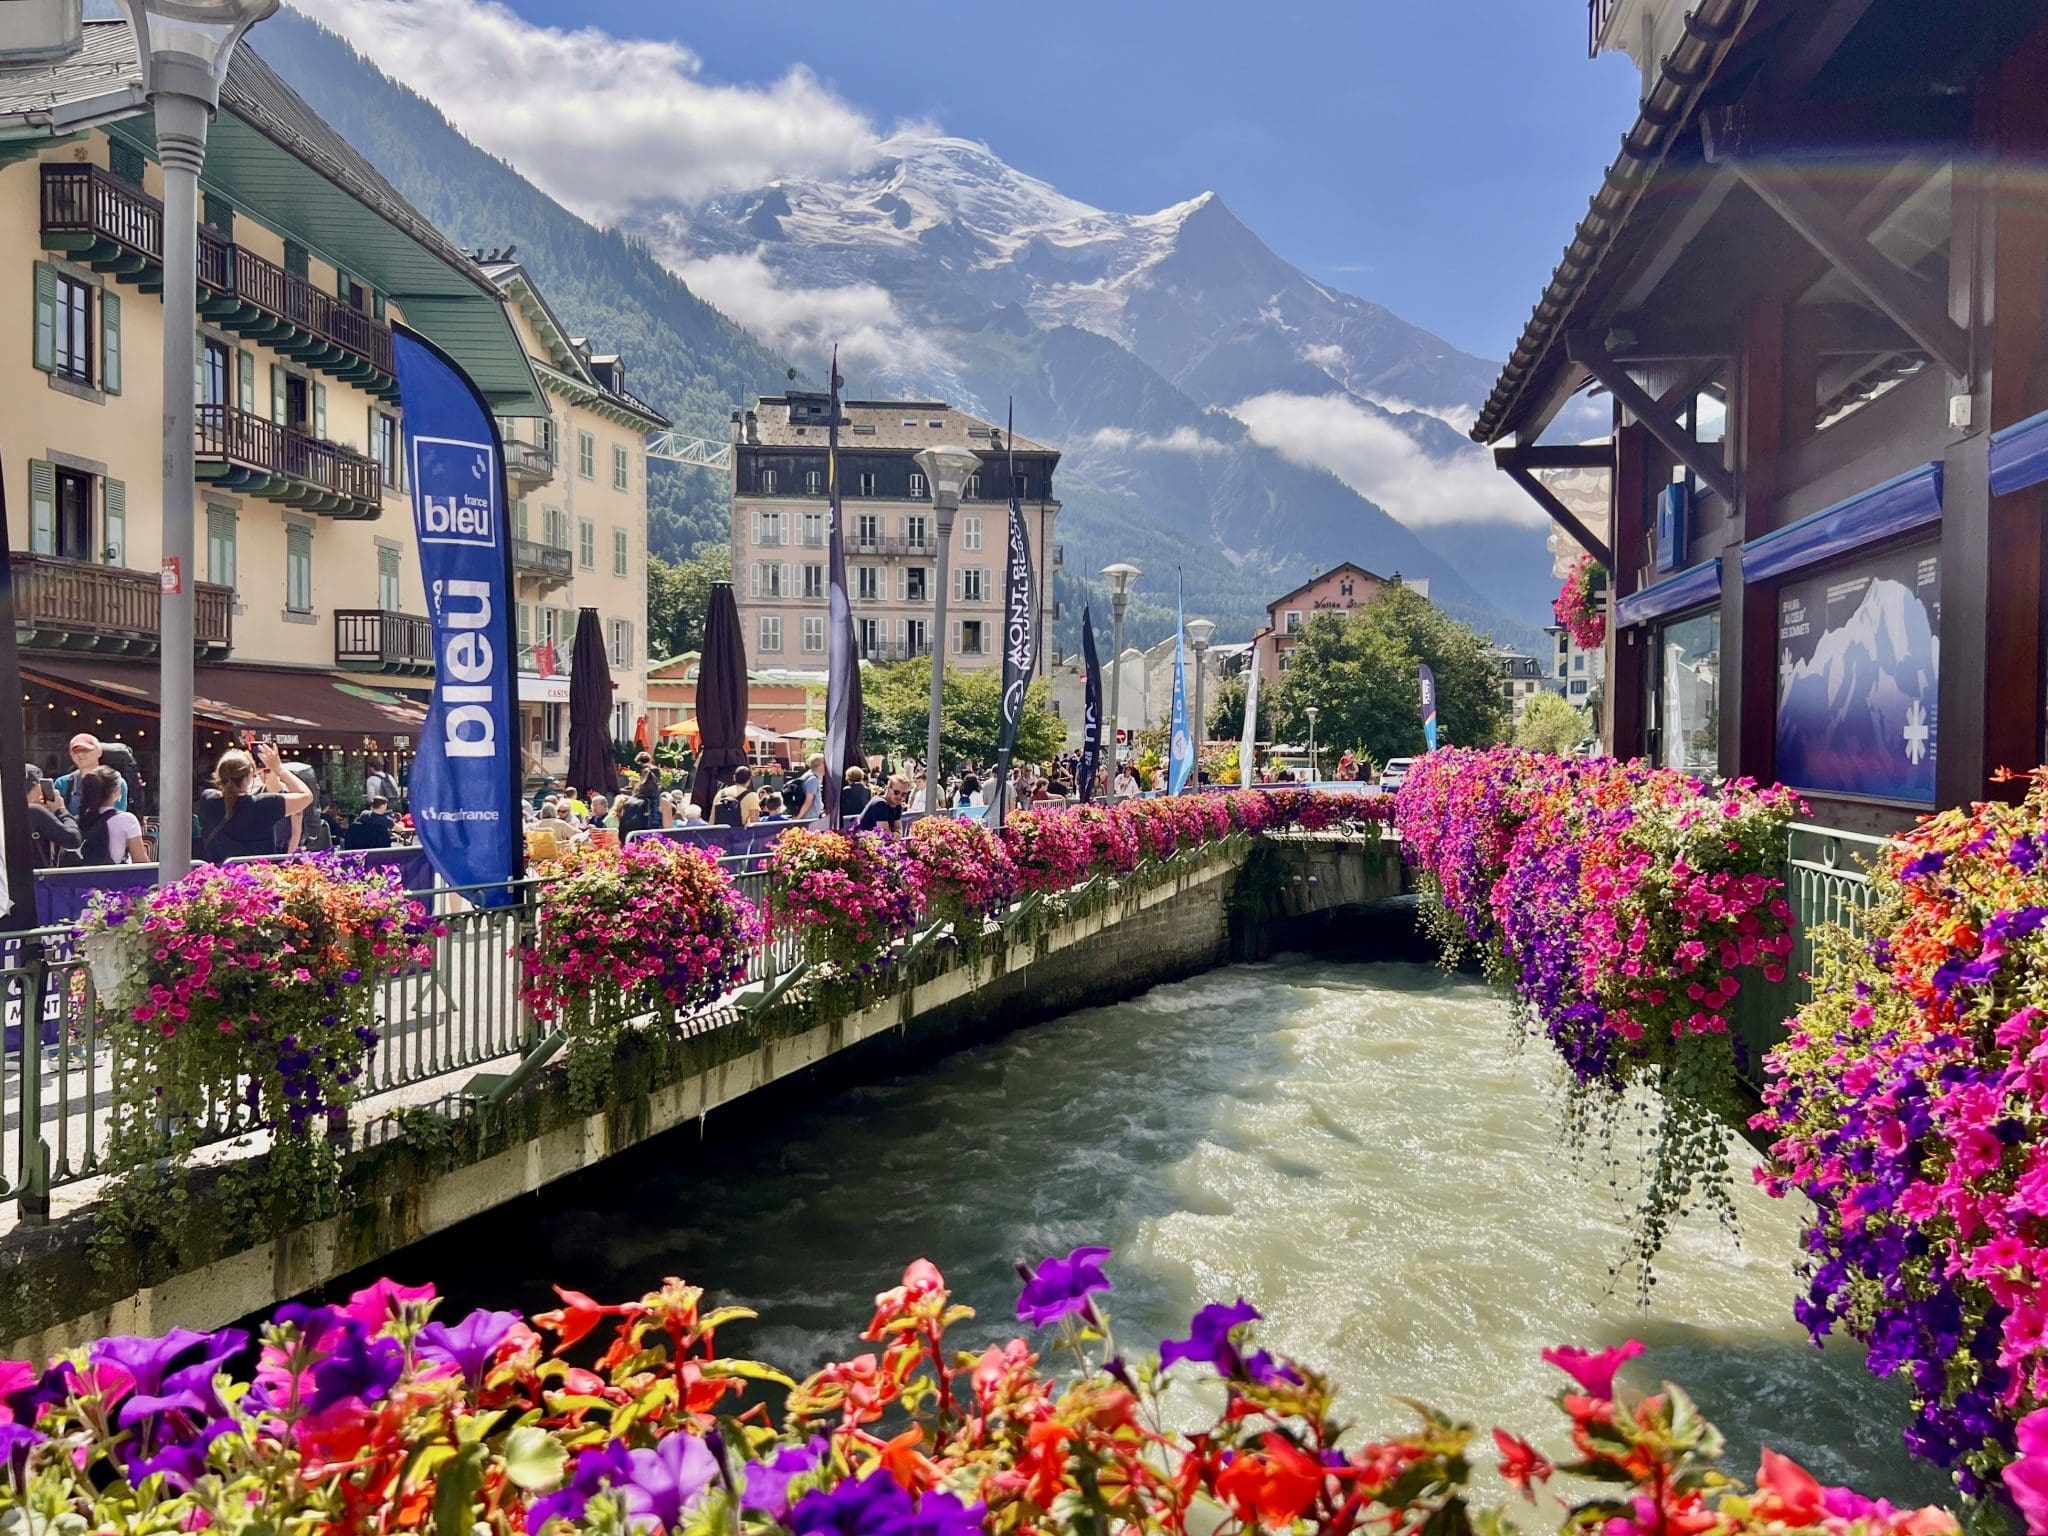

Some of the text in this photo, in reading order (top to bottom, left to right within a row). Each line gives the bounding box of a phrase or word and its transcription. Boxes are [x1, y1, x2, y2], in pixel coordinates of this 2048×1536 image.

[424, 495, 488, 535] bleu
[464, 494, 488, 507] france
[1341, 584, 1353, 596] H
[1008, 586, 1023, 669] MONT
[1019, 580, 1031, 670] NATURAL
[443, 579, 495, 757] bleu
[547, 689, 568, 698] CASIN
